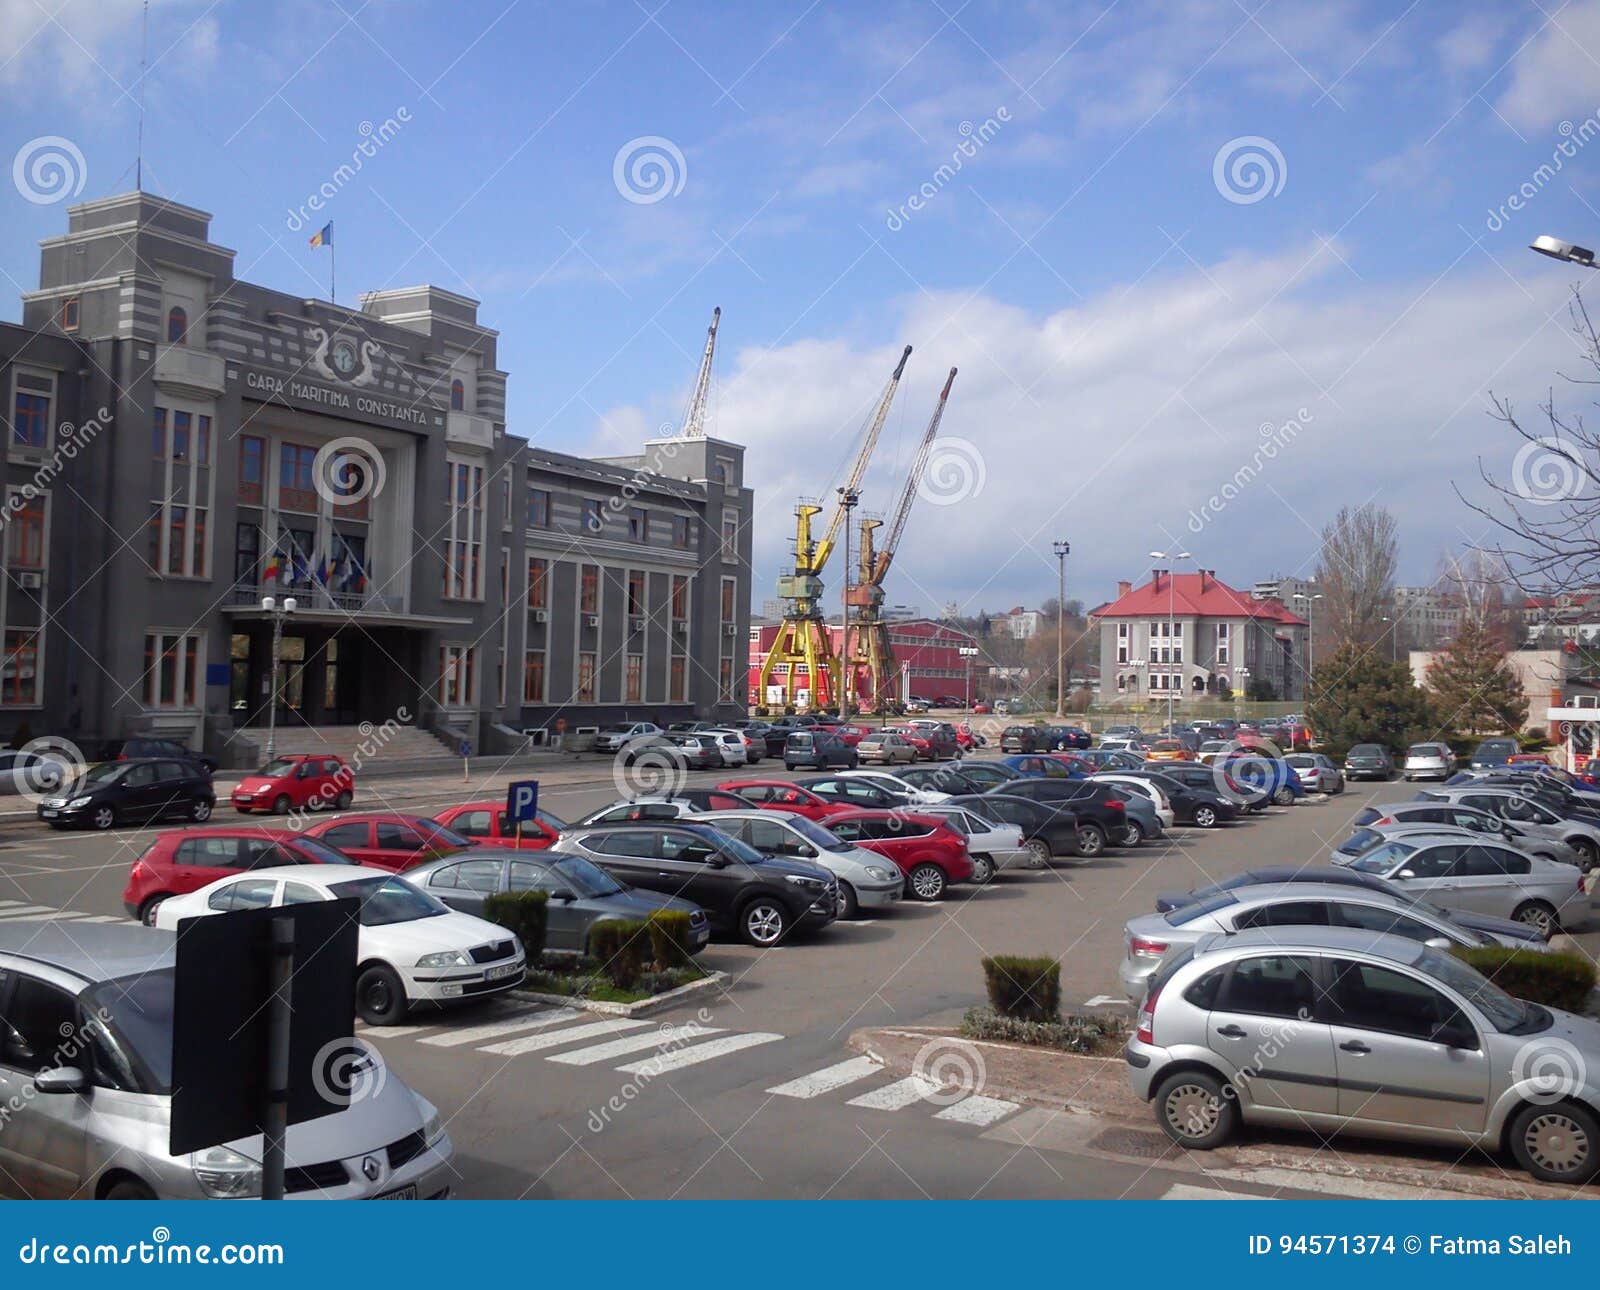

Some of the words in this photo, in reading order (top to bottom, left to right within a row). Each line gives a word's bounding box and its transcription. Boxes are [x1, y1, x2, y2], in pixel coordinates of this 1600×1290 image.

[291, 382, 350, 409] MARITIMA
[356, 397, 427, 425] CONSTANTA
[514, 786, 534, 818] P
